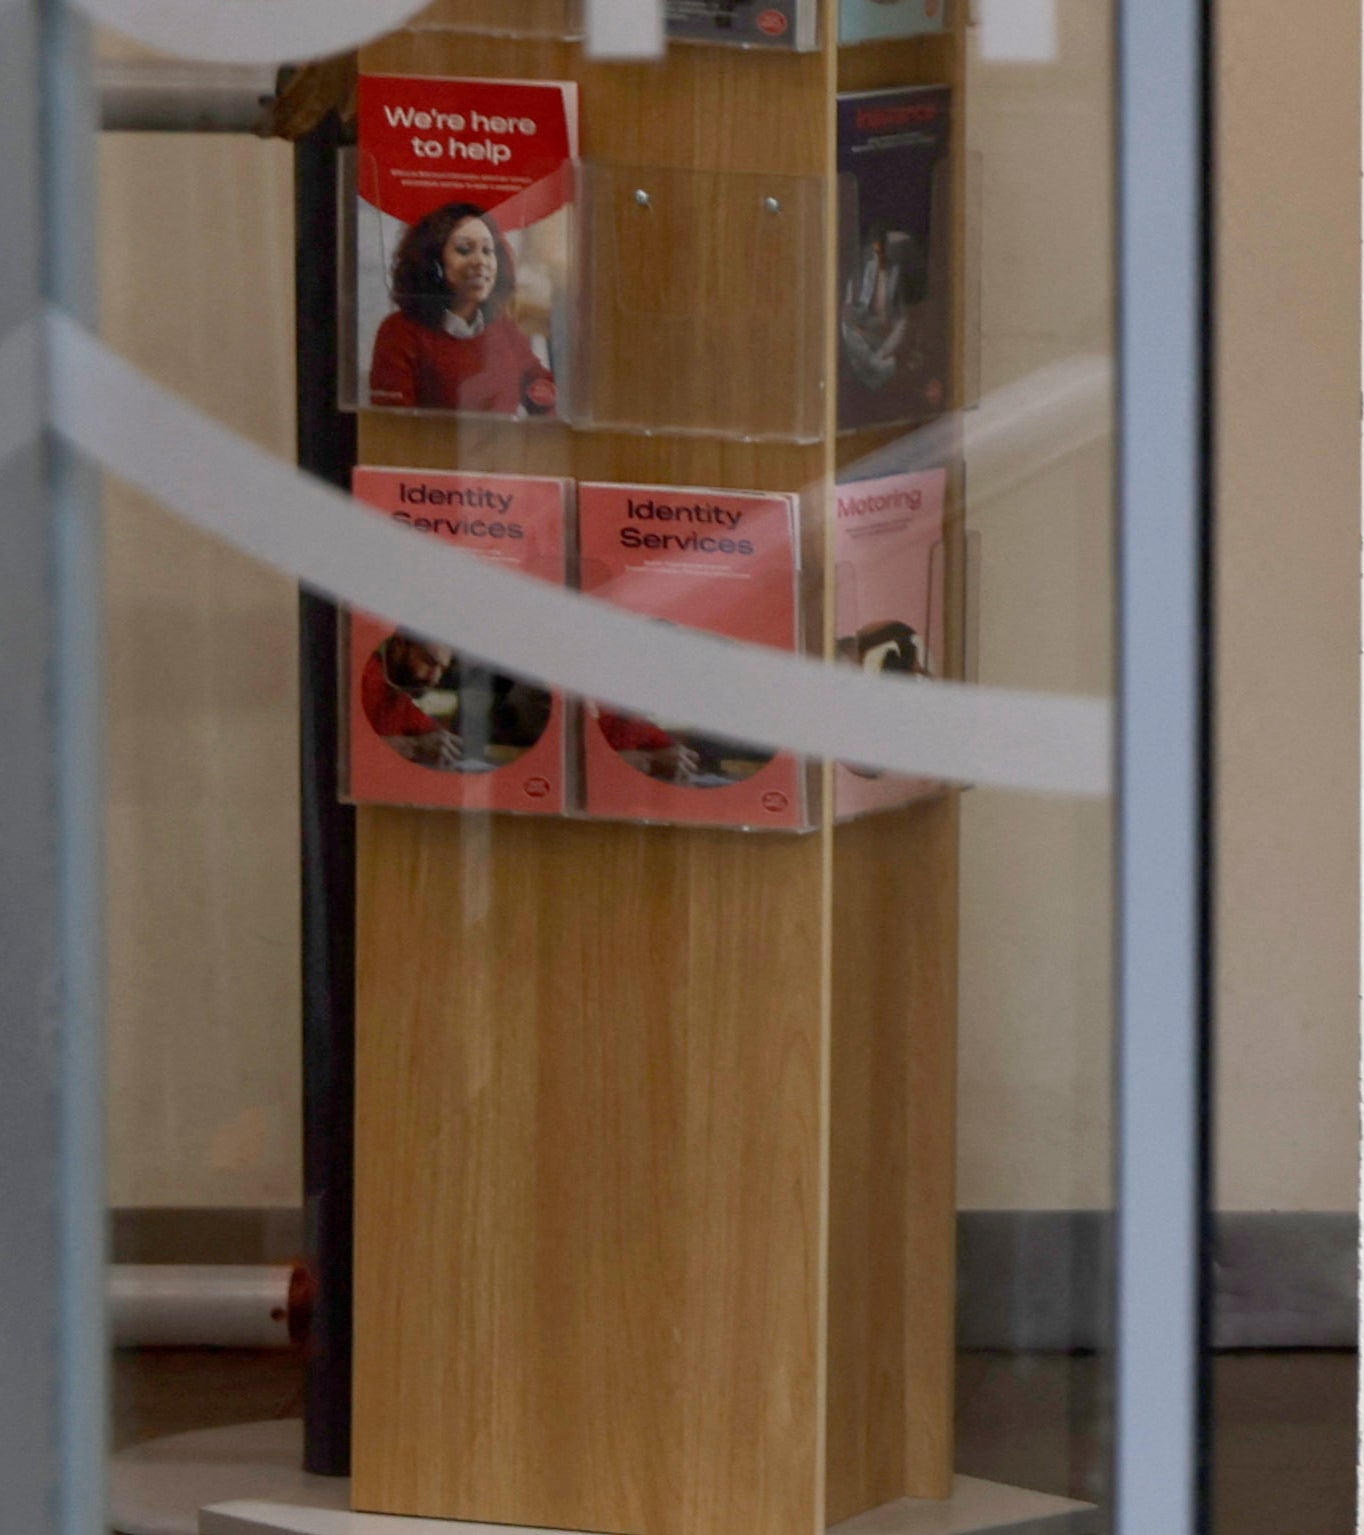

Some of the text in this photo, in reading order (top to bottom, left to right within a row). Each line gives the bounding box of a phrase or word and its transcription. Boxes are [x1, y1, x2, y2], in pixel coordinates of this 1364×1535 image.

[383, 104, 537, 136] We're here
[411, 136, 512, 165] to help
[399, 483, 515, 513] Identity
[627, 499, 743, 529] Identity
[620, 526, 755, 555] Services
